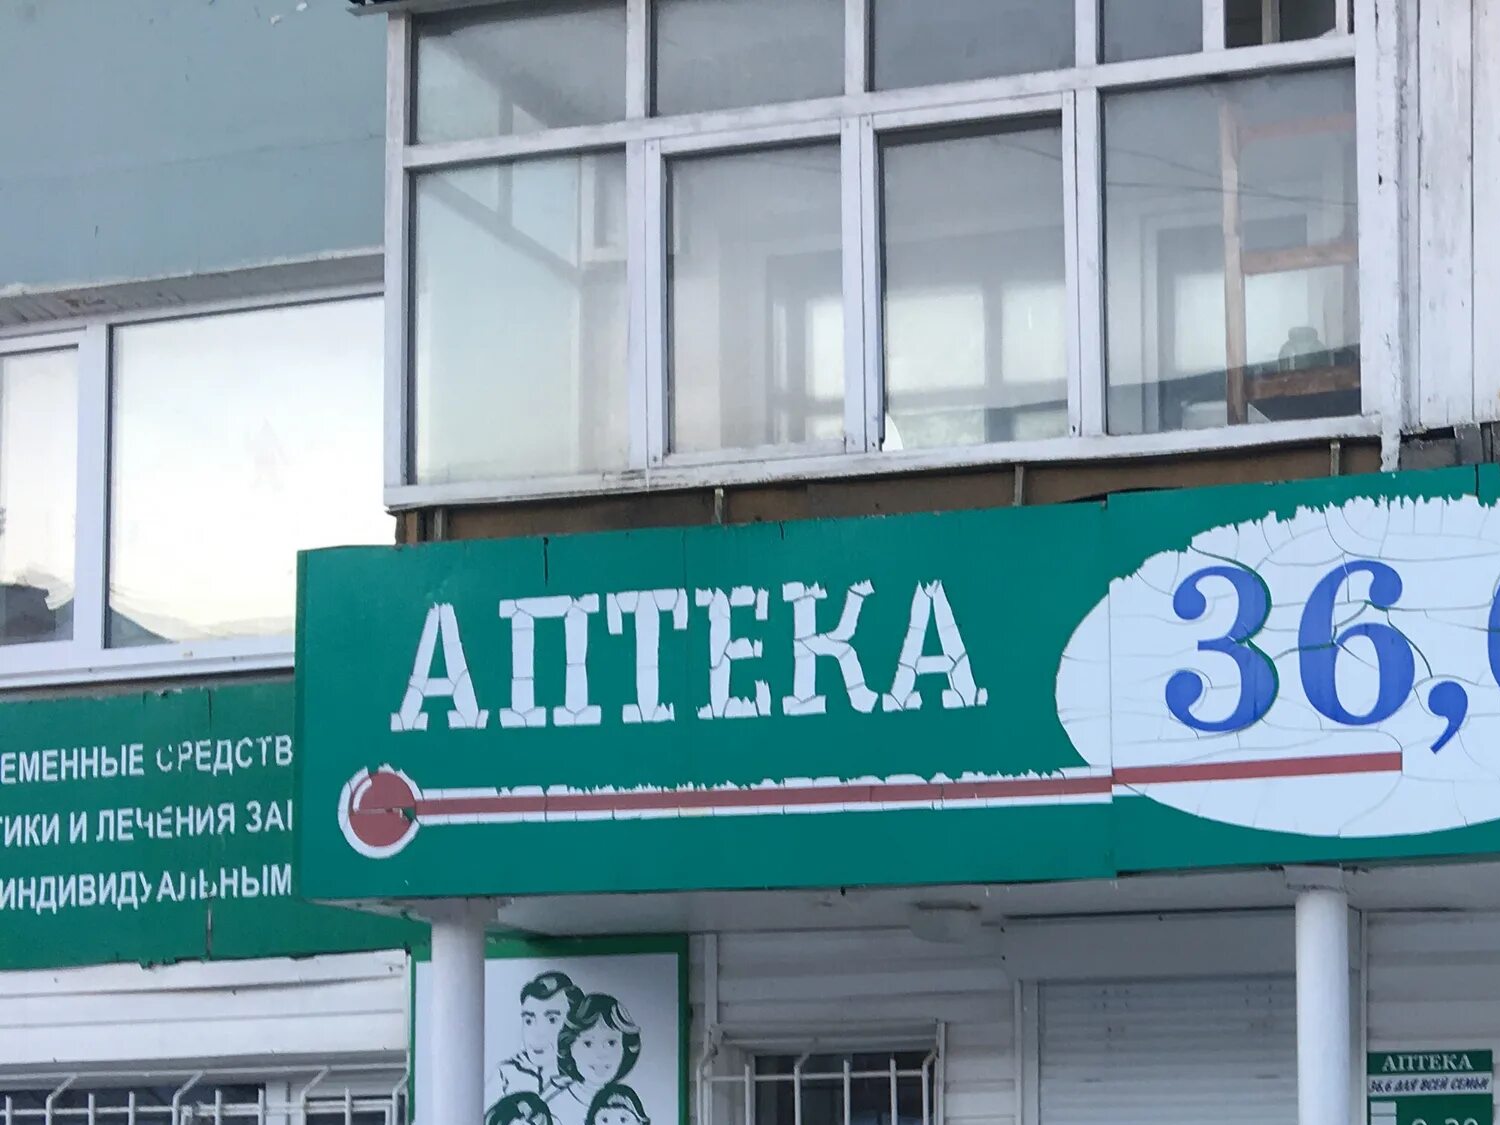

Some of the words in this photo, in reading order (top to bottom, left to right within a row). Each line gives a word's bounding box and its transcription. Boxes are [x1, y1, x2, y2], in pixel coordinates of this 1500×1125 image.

[390, 579, 988, 731] АПТЕКА
[0, 743, 145, 785] ЕМЕННЫЕ
[155, 734, 294, 777] СРЕДСТВ
[0, 812, 60, 848] ИКИ
[69, 810, 88, 844] И
[95, 802, 236, 842] ЛЕЧЕНИЯ
[1381, 1053, 1474, 1073] АПТЕКА
